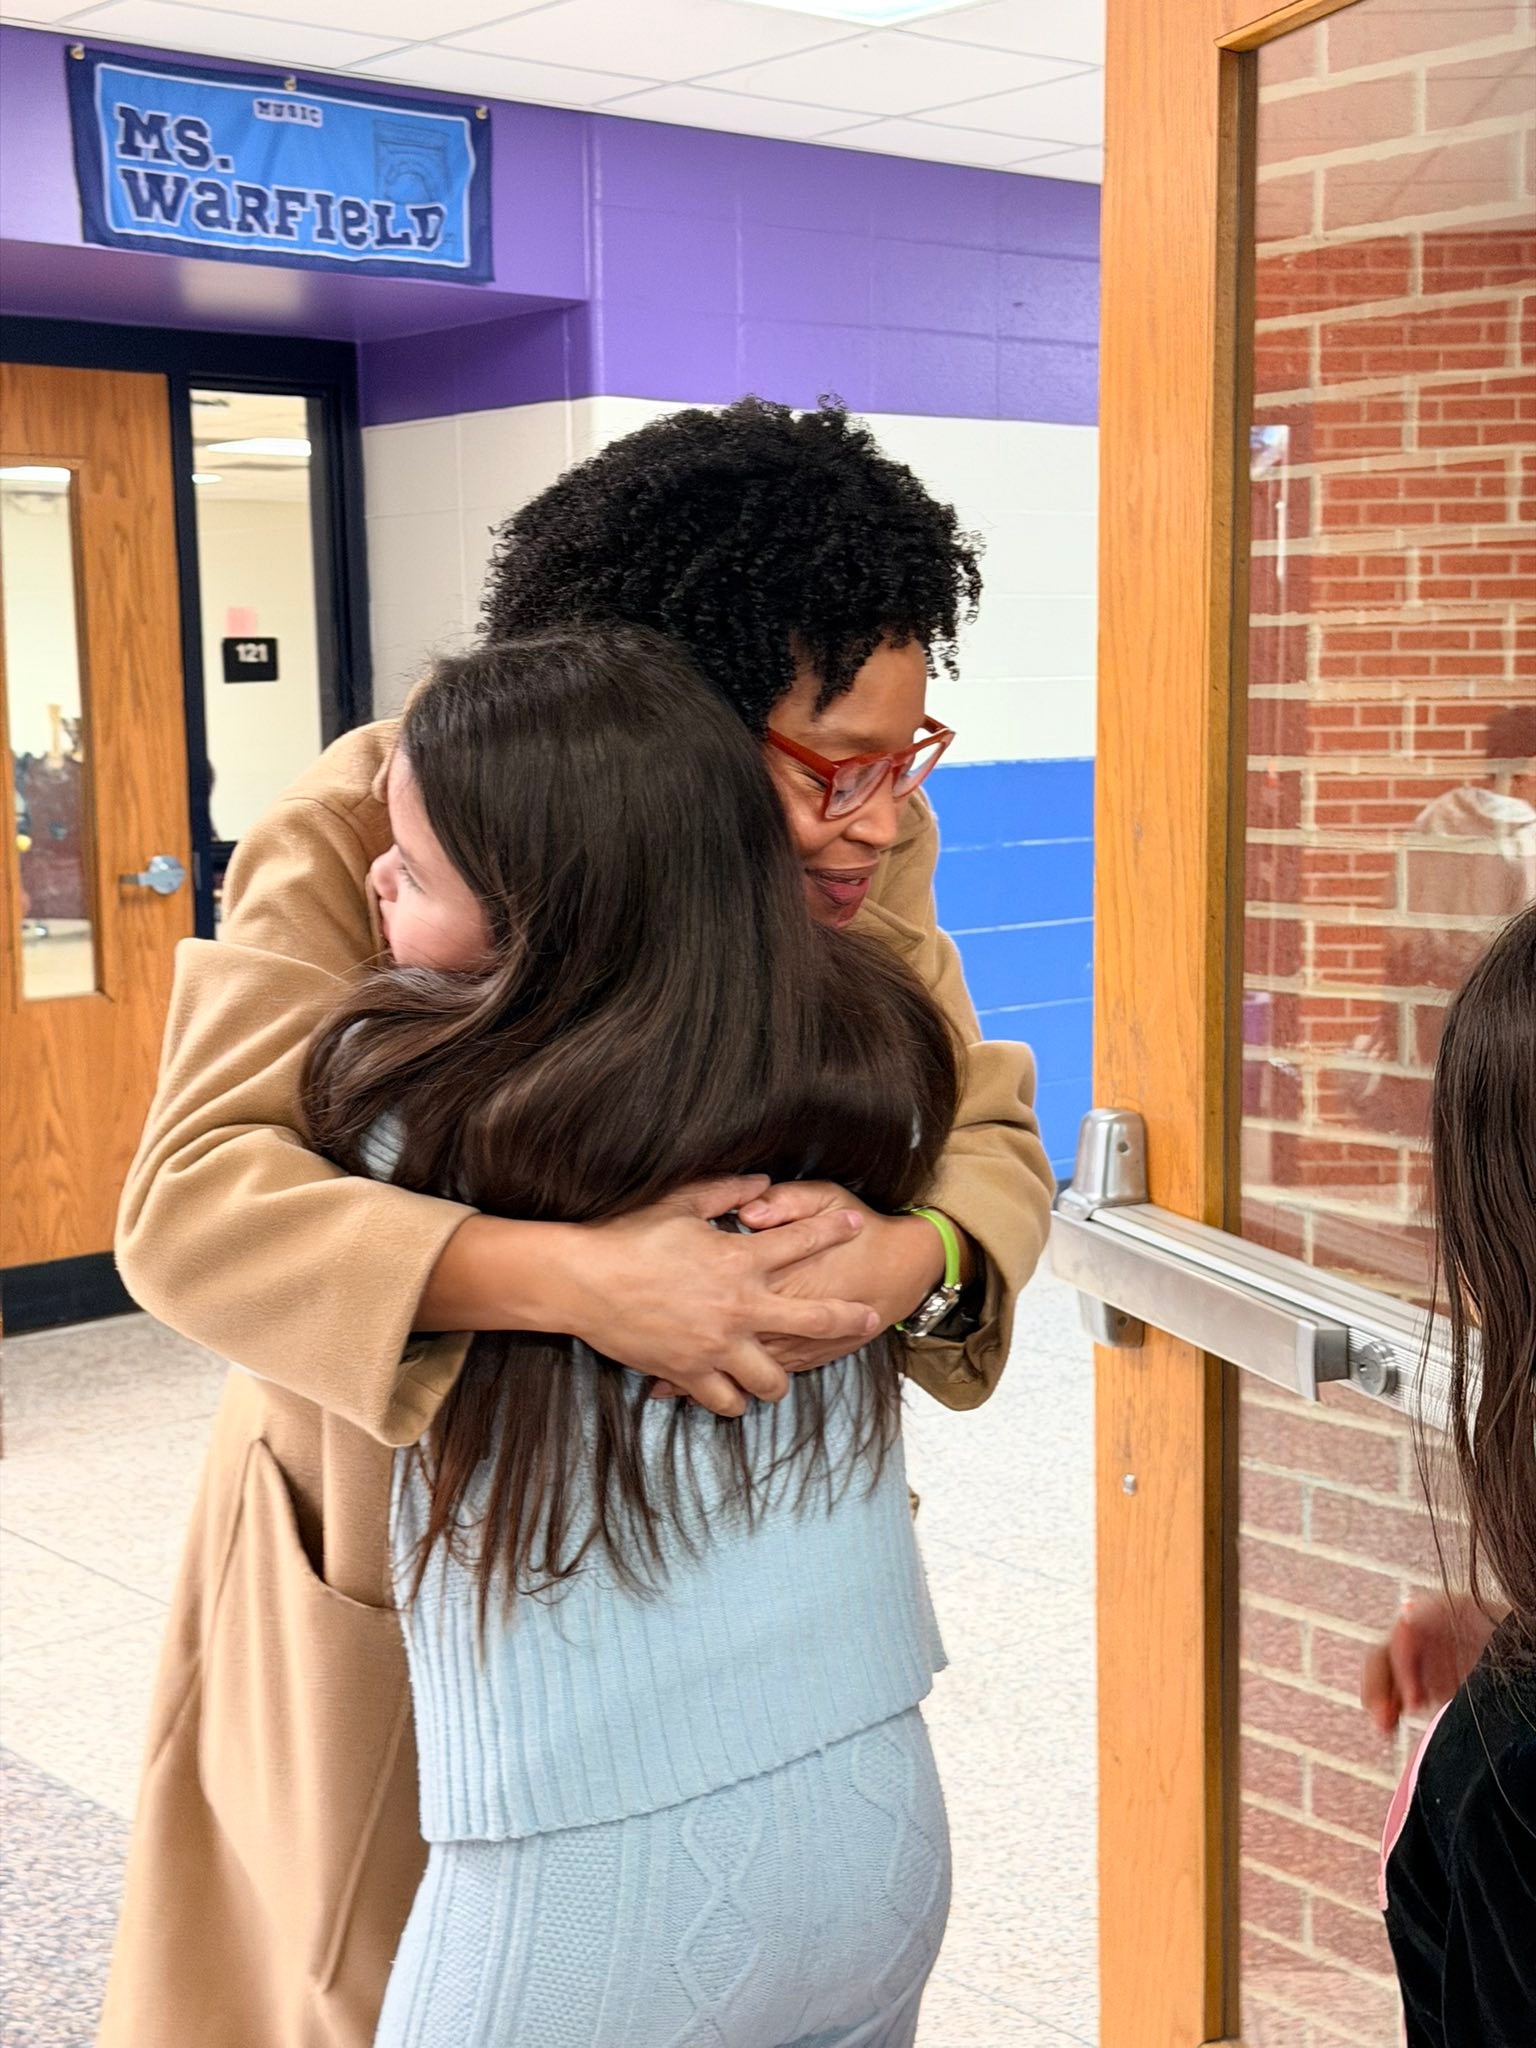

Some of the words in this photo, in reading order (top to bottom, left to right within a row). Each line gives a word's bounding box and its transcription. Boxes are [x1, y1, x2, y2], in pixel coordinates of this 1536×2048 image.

[256, 101, 319, 123] MUSIC
[117, 105, 233, 171] MS.
[235, 643, 269, 663] 121
